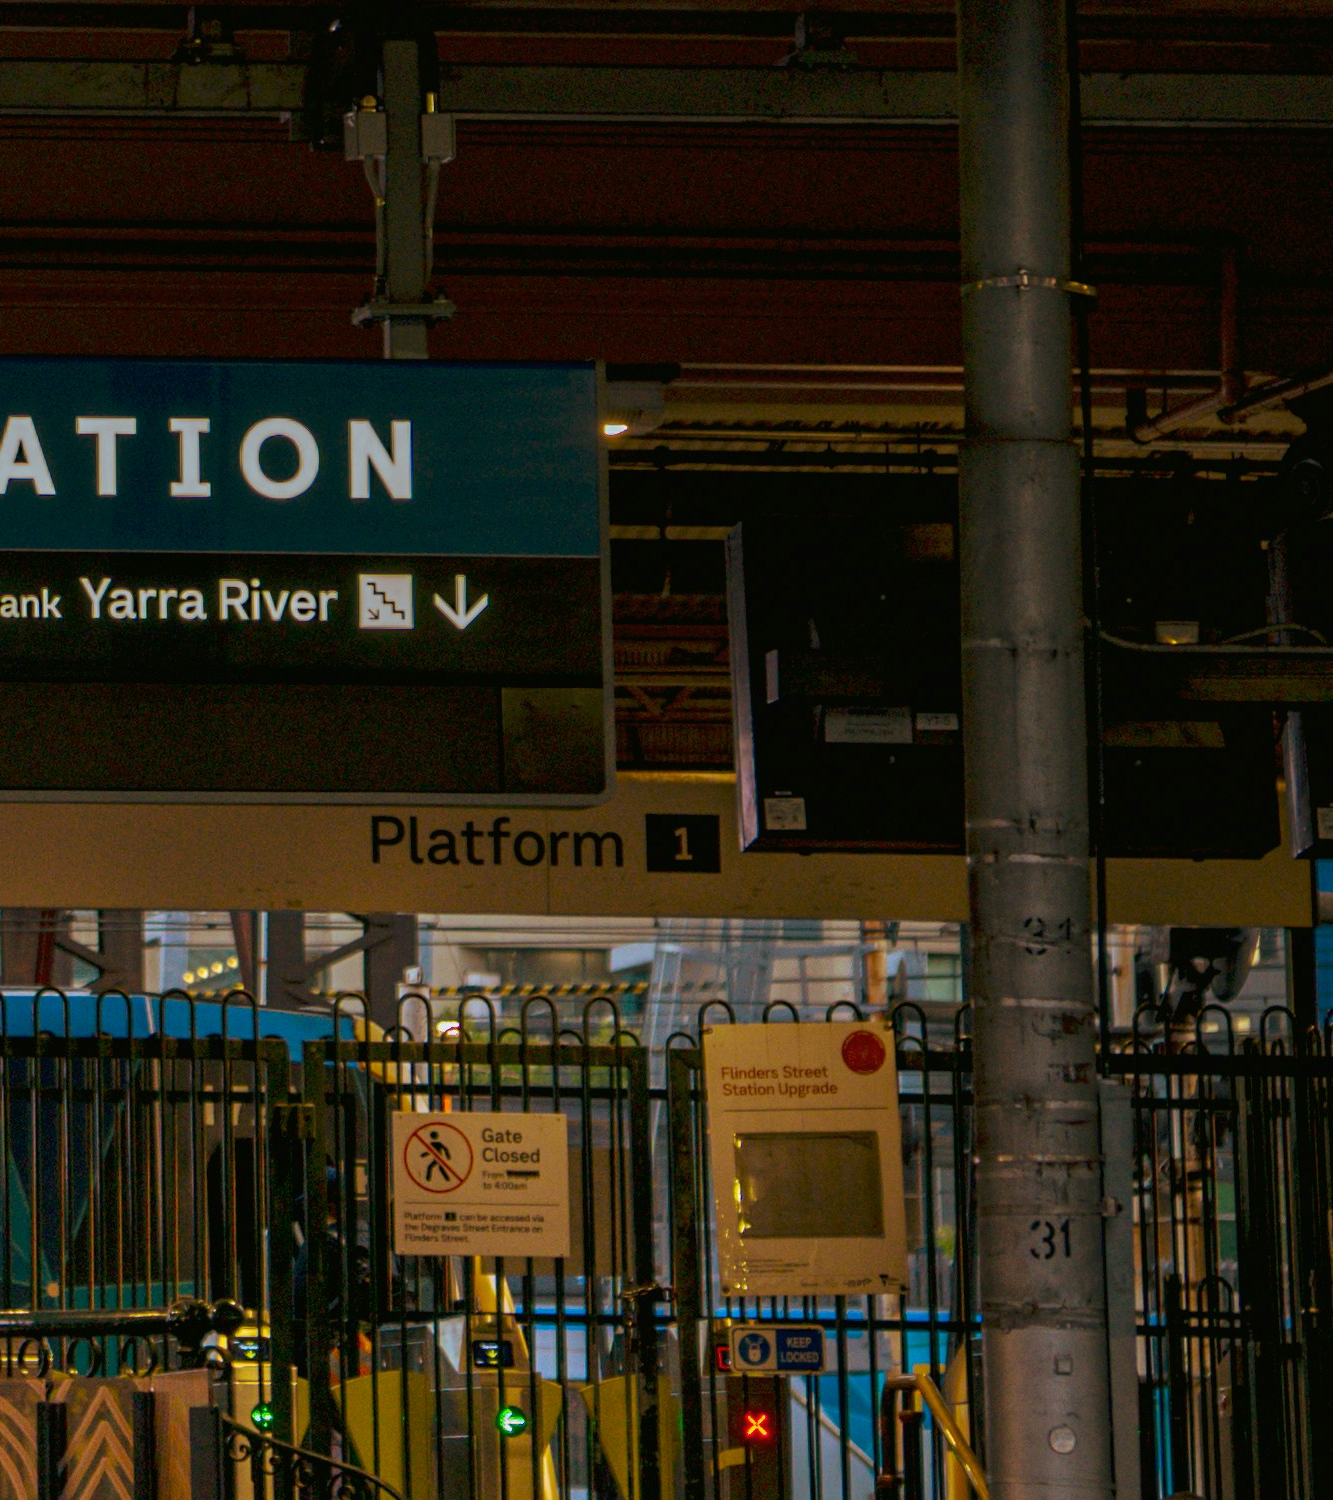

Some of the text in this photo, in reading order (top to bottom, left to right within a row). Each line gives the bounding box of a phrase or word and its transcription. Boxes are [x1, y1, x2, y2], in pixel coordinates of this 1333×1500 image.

[79, 576, 208, 621] Yarra
[217, 578, 337, 621] River
[370, 814, 693, 868] Platform 1
[721, 1065, 829, 1080] Flinders Street
[723, 1081, 838, 1098] Station Upgrade
[482, 1127, 523, 1144] Gate
[482, 1147, 541, 1163] Closed
[1029, 1218, 1074, 1260] 31
[787, 1337, 811, 1348] KEEP
[781, 1351, 819, 1363] LOCKED
